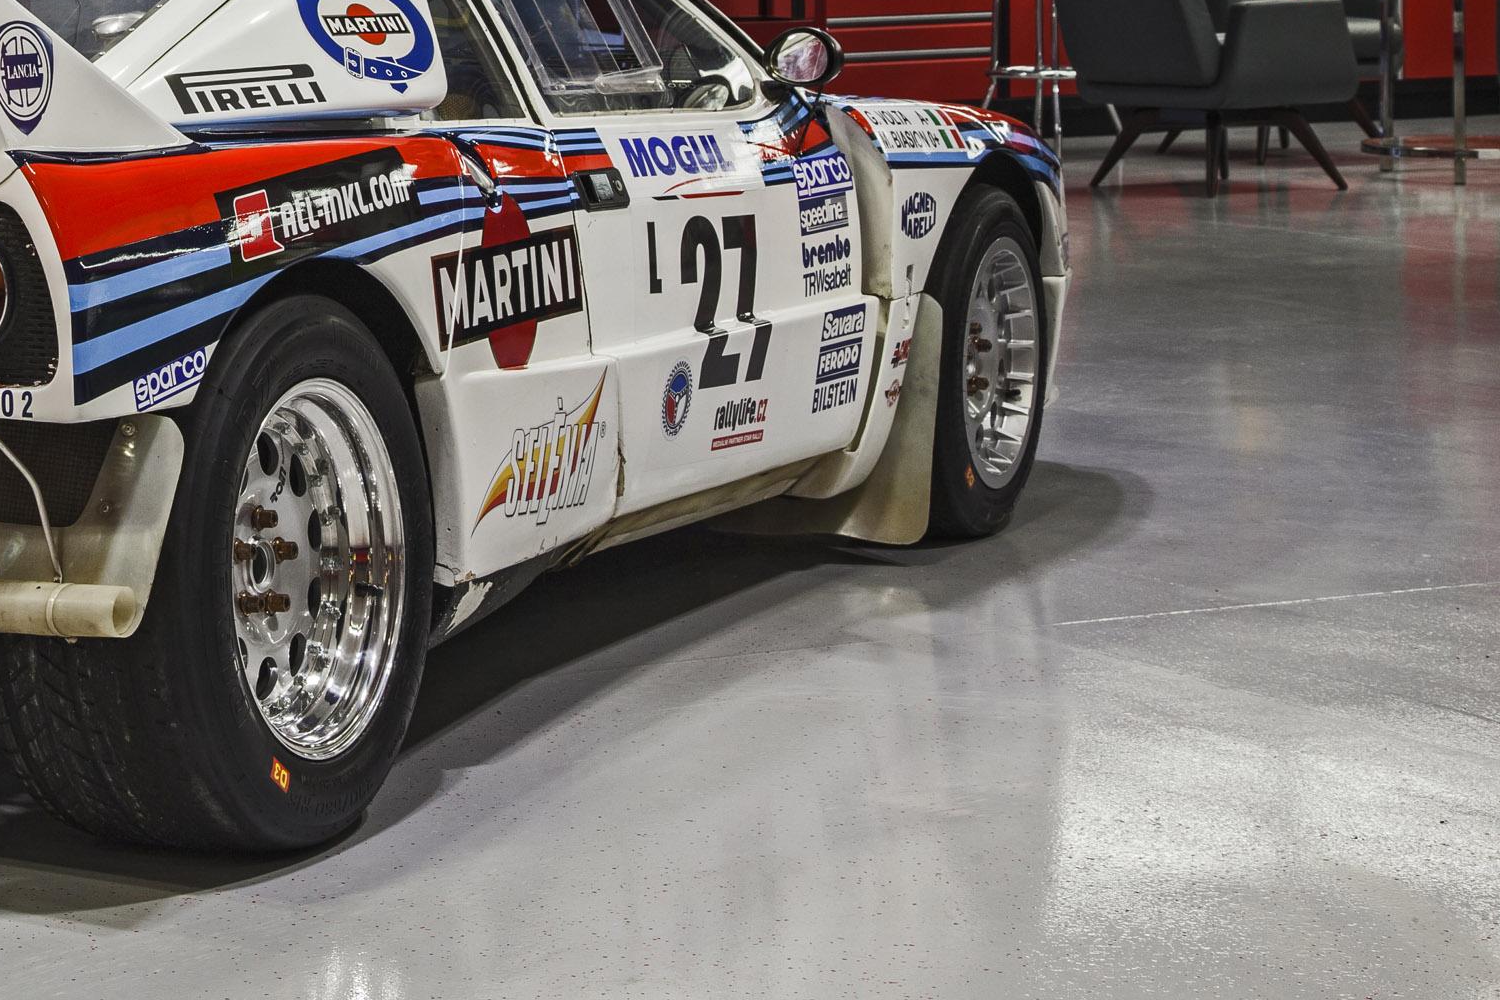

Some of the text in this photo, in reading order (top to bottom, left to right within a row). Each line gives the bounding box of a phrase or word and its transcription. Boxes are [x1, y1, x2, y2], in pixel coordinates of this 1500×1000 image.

[326, 16, 405, 34] MARTINI
[6, 63, 38, 79] LANCIA
[163, 63, 327, 115] PIRELLI
[619, 135, 736, 178] MOGUL
[793, 156, 851, 196] sparco
[800, 198, 843, 231] speedline
[902, 213, 937, 240] MARELLI
[802, 234, 851, 268] brembo
[439, 238, 576, 335] MARTINI
[680, 214, 773, 390] 27
[823, 311, 864, 339] Savara
[819, 344, 859, 375] FERODO
[136, 350, 206, 405] sparco
[21, 391, 33, 418] 2
[812, 378, 858, 414] BILSTEIN
[714, 397, 768, 431] rallylife.cz
[273, 762, 288, 789] D3
